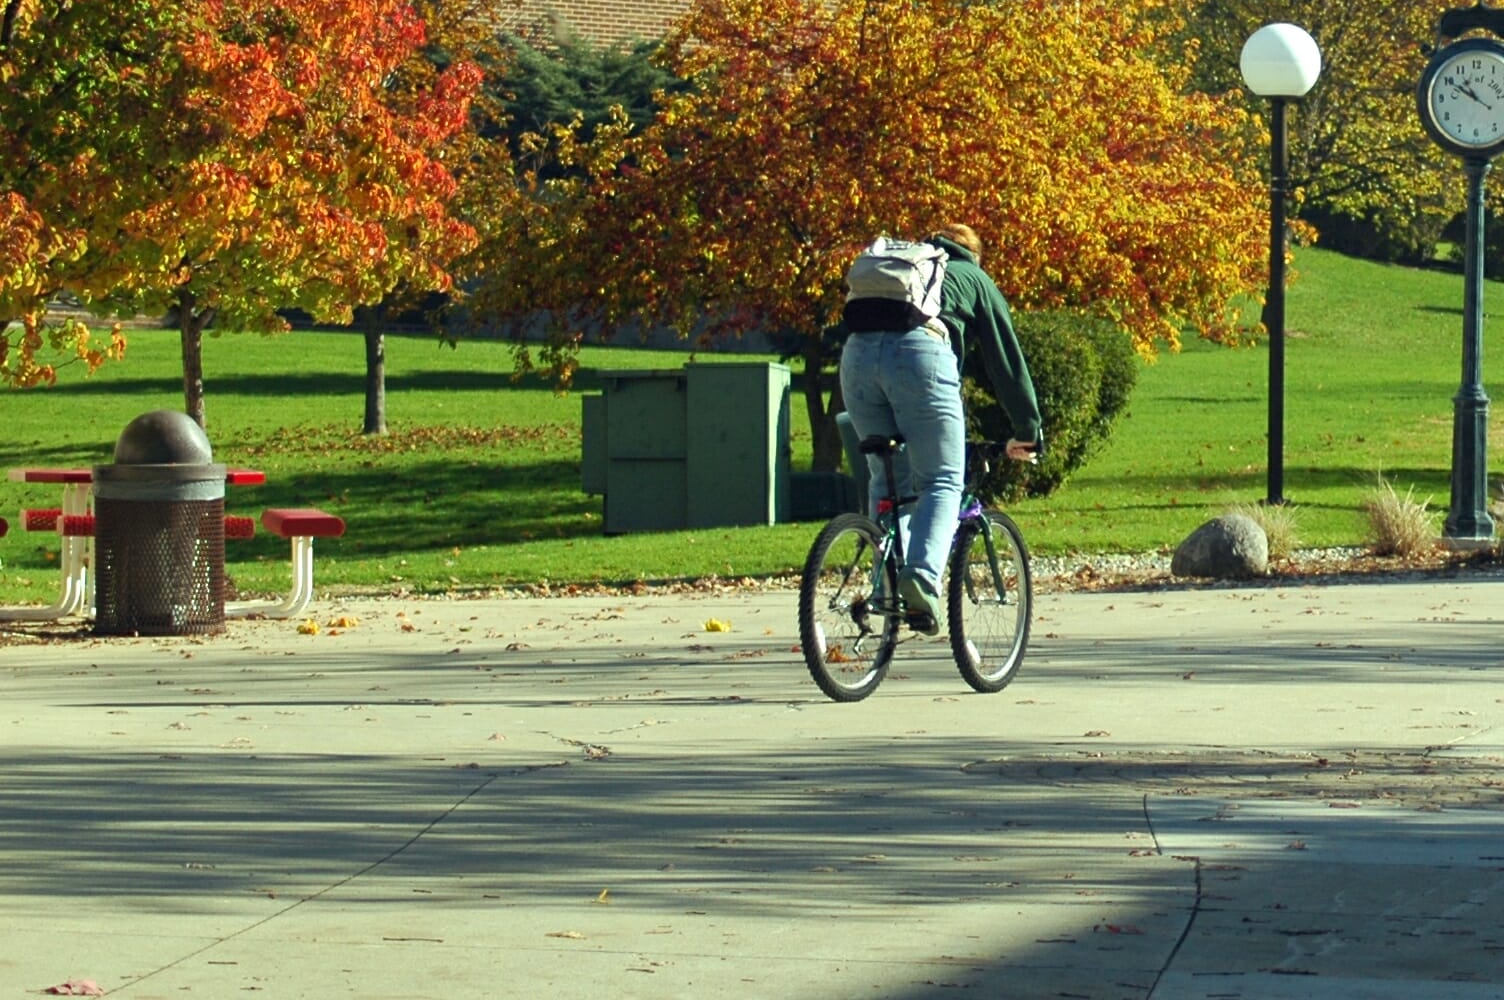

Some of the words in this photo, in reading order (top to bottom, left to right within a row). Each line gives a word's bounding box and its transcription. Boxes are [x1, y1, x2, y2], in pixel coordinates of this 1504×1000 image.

[1456, 65, 1465, 75] 11
[1472, 60, 1482, 70] 12
[1444, 76, 1454, 86] 10
[1474, 75, 1485, 84] of
[1438, 94, 1444, 103] 9
[1444, 112, 1450, 121] 8
[1457, 123, 1462, 133] 7
[1491, 122, 1497, 132] 5
[1473, 128, 1479, 137] 6
